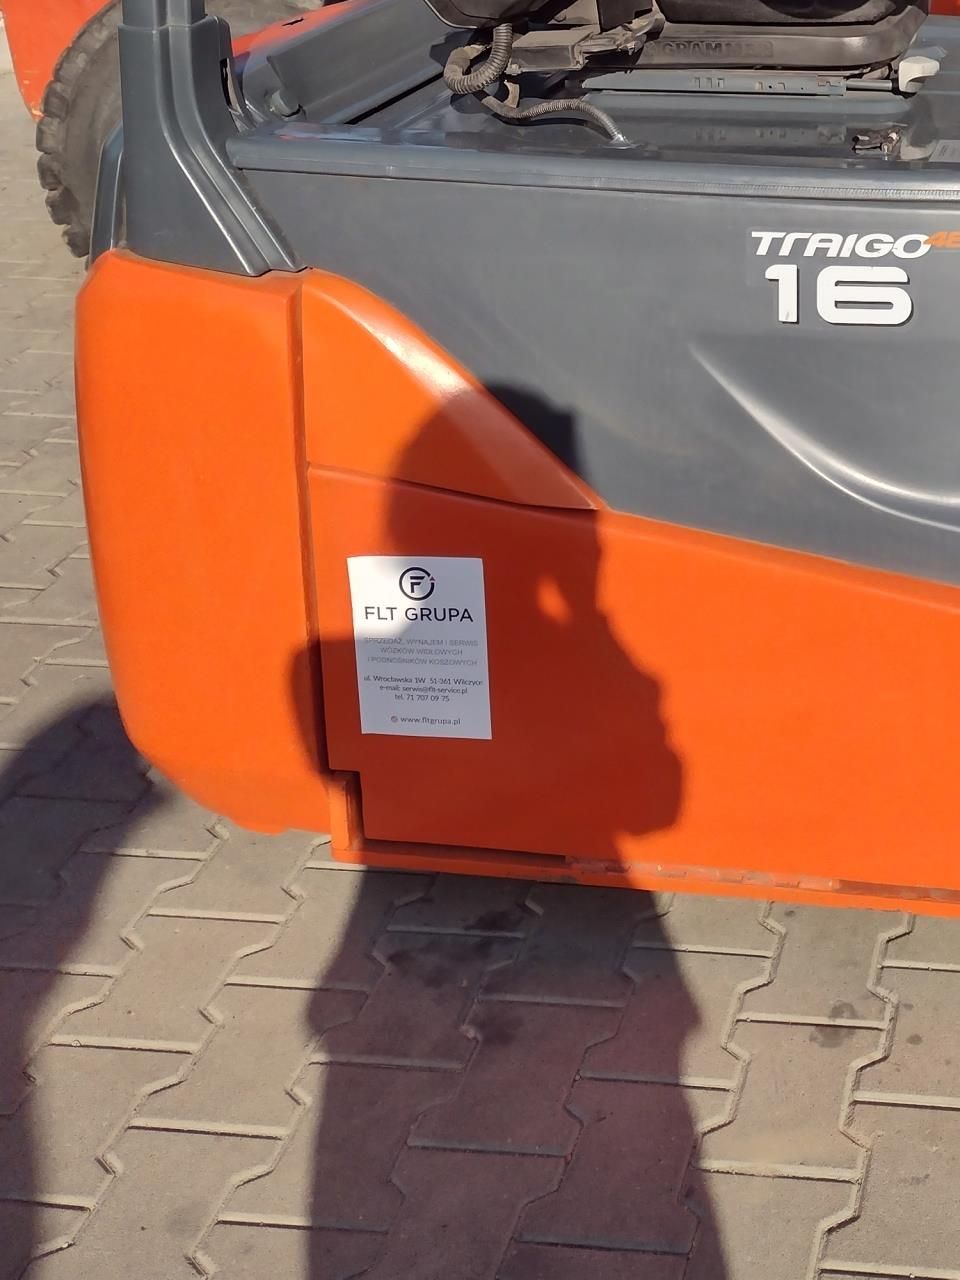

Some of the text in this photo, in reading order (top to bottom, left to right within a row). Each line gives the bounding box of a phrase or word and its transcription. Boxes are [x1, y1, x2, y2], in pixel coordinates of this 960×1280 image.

[764, 264, 914, 325] 16
[364, 606, 474, 623] FLT GRUPA
